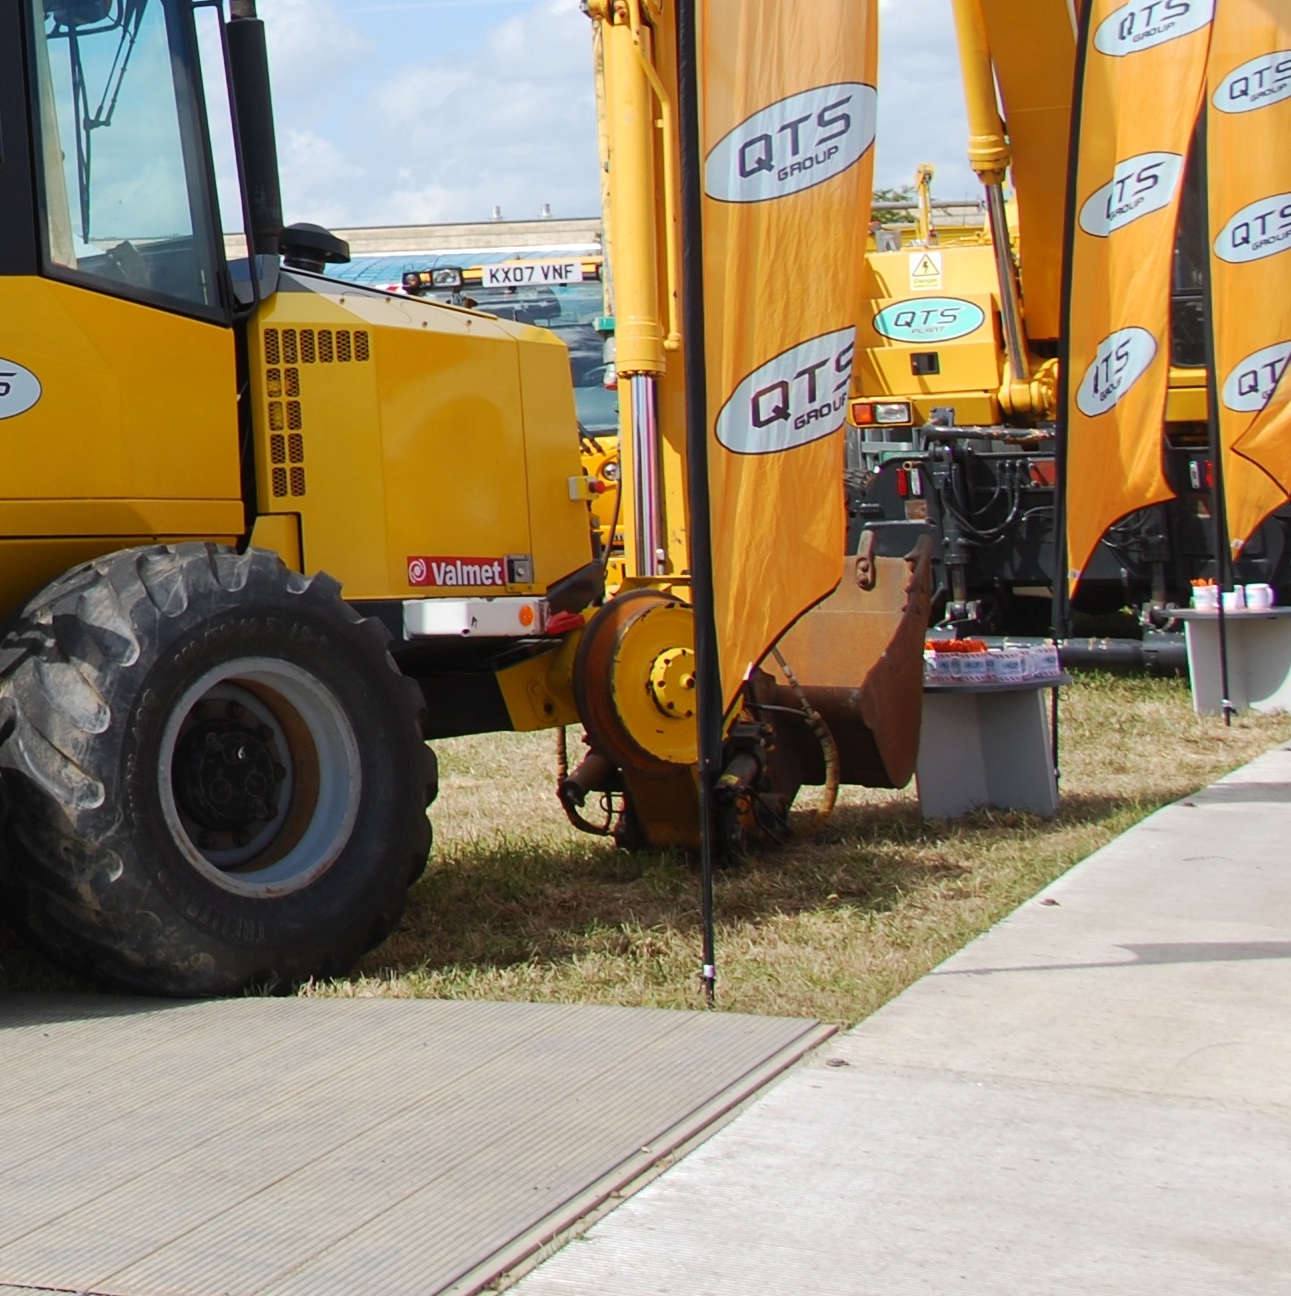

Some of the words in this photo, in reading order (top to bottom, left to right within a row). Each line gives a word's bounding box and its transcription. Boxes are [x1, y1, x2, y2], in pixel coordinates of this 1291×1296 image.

[1133, 22, 1175, 43] GROUP
[1229, 60, 1291, 100] QTS
[1249, 83, 1287, 102] GROUP
[738, 95, 852, 178] QTS
[778, 146, 839, 181] GROUP
[1106, 161, 1167, 219] TS
[490, 266, 534, 284] KX07
[541, 264, 574, 280] VNF
[894, 307, 962, 328] QTS
[751, 341, 854, 428] QTS
[1093, 337, 1132, 398] TS
[1238, 357, 1285, 396] QT
[794, 392, 846, 430] GROUP
[431, 560, 502, 586] Valmet
